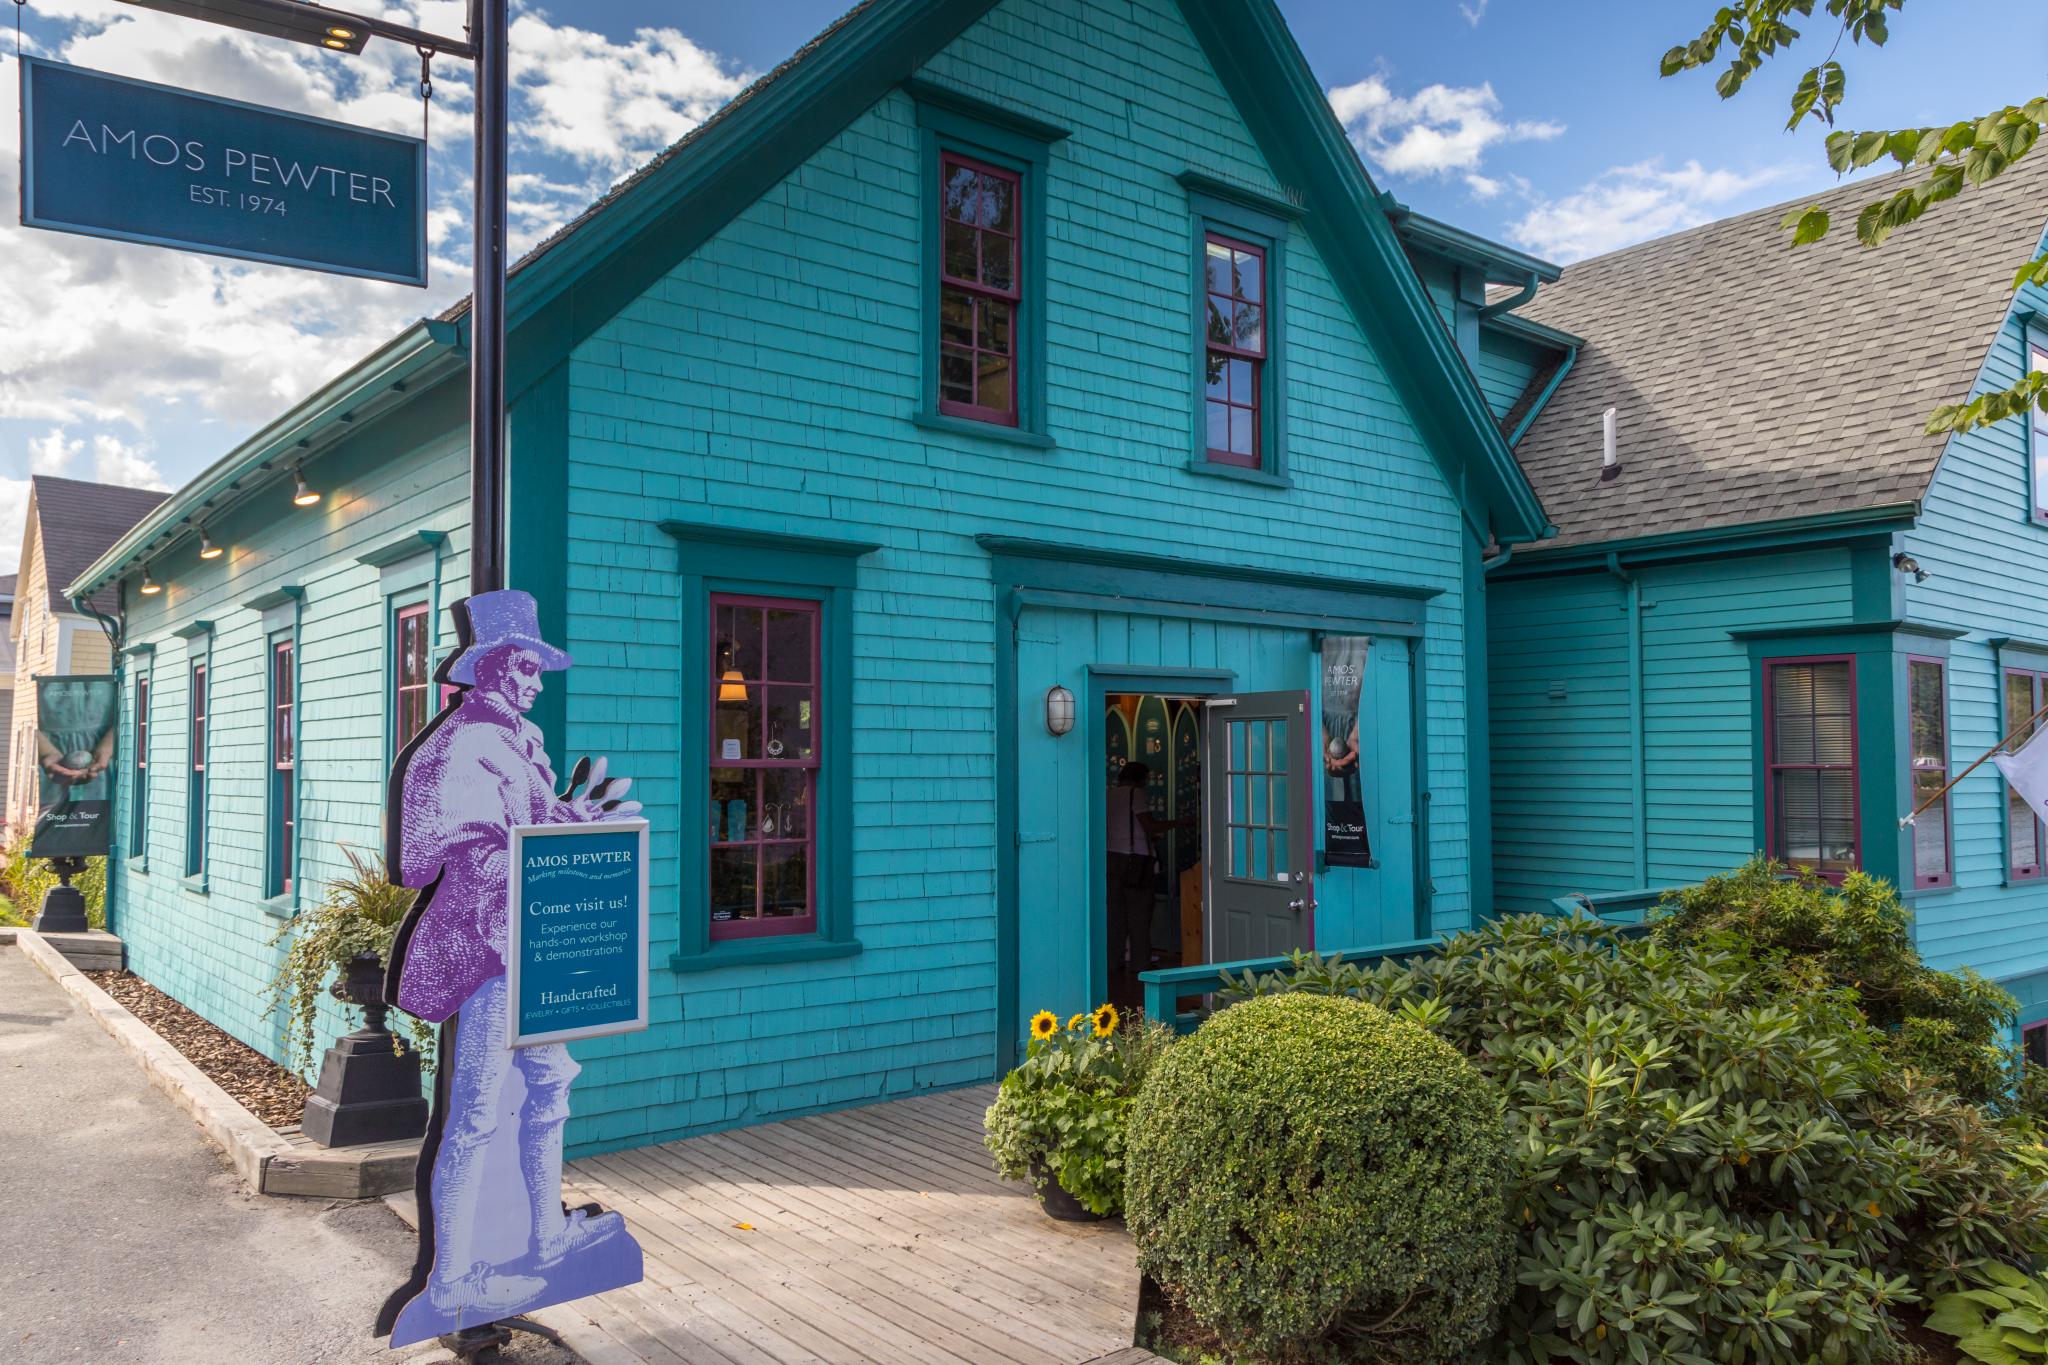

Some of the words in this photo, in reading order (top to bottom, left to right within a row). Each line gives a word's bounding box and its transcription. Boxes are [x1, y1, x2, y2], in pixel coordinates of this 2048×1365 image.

[62, 119, 205, 172] AMOS
[225, 148, 397, 208] PEWTER
[189, 184, 231, 208] EST.
[240, 192, 288, 217] 1974
[1327, 664, 1356, 675] AMOS
[46, 813, 67, 822] Shop
[79, 811, 99, 820] Tour
[1327, 822, 1340, 834] Shop
[1347, 823, 1363, 832] Tour
[526, 854, 568, 868] AMOS
[573, 851, 632, 865] PEWTER
[527, 870, 556, 884] Marking
[557, 866, 588, 880] milestones
[588, 872, 603, 880] and
[603, 867, 632, 880] memories
[529, 901, 571, 916] Come
[575, 896, 605, 912] visit
[609, 895, 628, 909] us!
[541, 921, 598, 935] Experience
[600, 919, 618, 929] our
[529, 937, 576, 949] hands-on
[579, 931, 628, 944] workshop
[534, 952, 543, 962] &
[546, 945, 623, 961] demonstrations
[540, 983, 617, 1005] Handcrafted
[560, 1004, 580, 1015] GIFTS
[585, 998, 632, 1012] COLLECTIBLES
